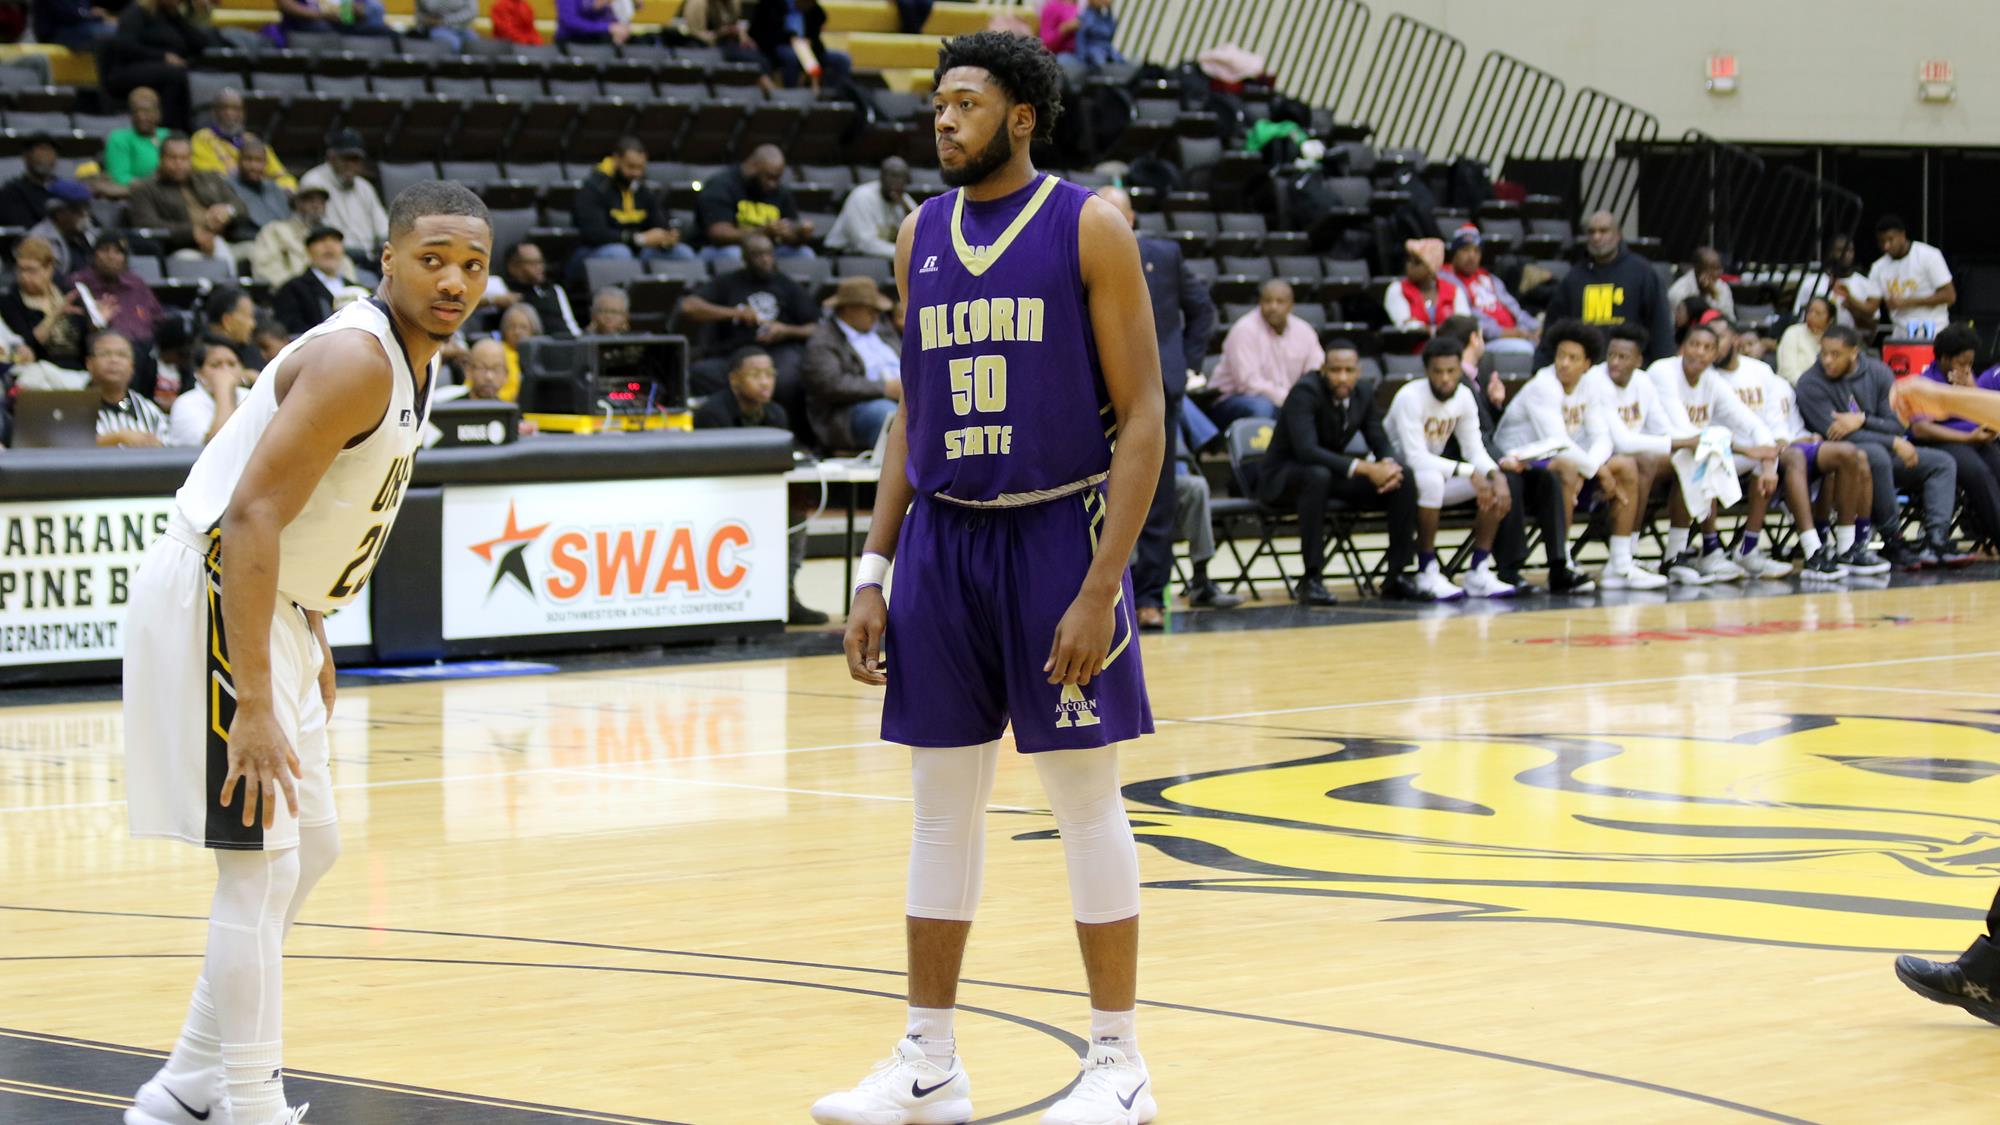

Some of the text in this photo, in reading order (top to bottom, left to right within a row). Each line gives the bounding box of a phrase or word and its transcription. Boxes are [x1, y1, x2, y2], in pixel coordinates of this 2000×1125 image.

[919, 298, 1045, 351] ALCORN
[949, 354, 1007, 416] 50
[945, 425, 1012, 460] SATE
[546, 524, 750, 600] SWAC
[0, 566, 140, 610] PINE B
[546, 601, 744, 622] SOUTHWESTERN ATHLETIC CONFERENCE
[0, 621, 117, 652] EPARTMENT
[1055, 699, 1097, 713] ALCORN
